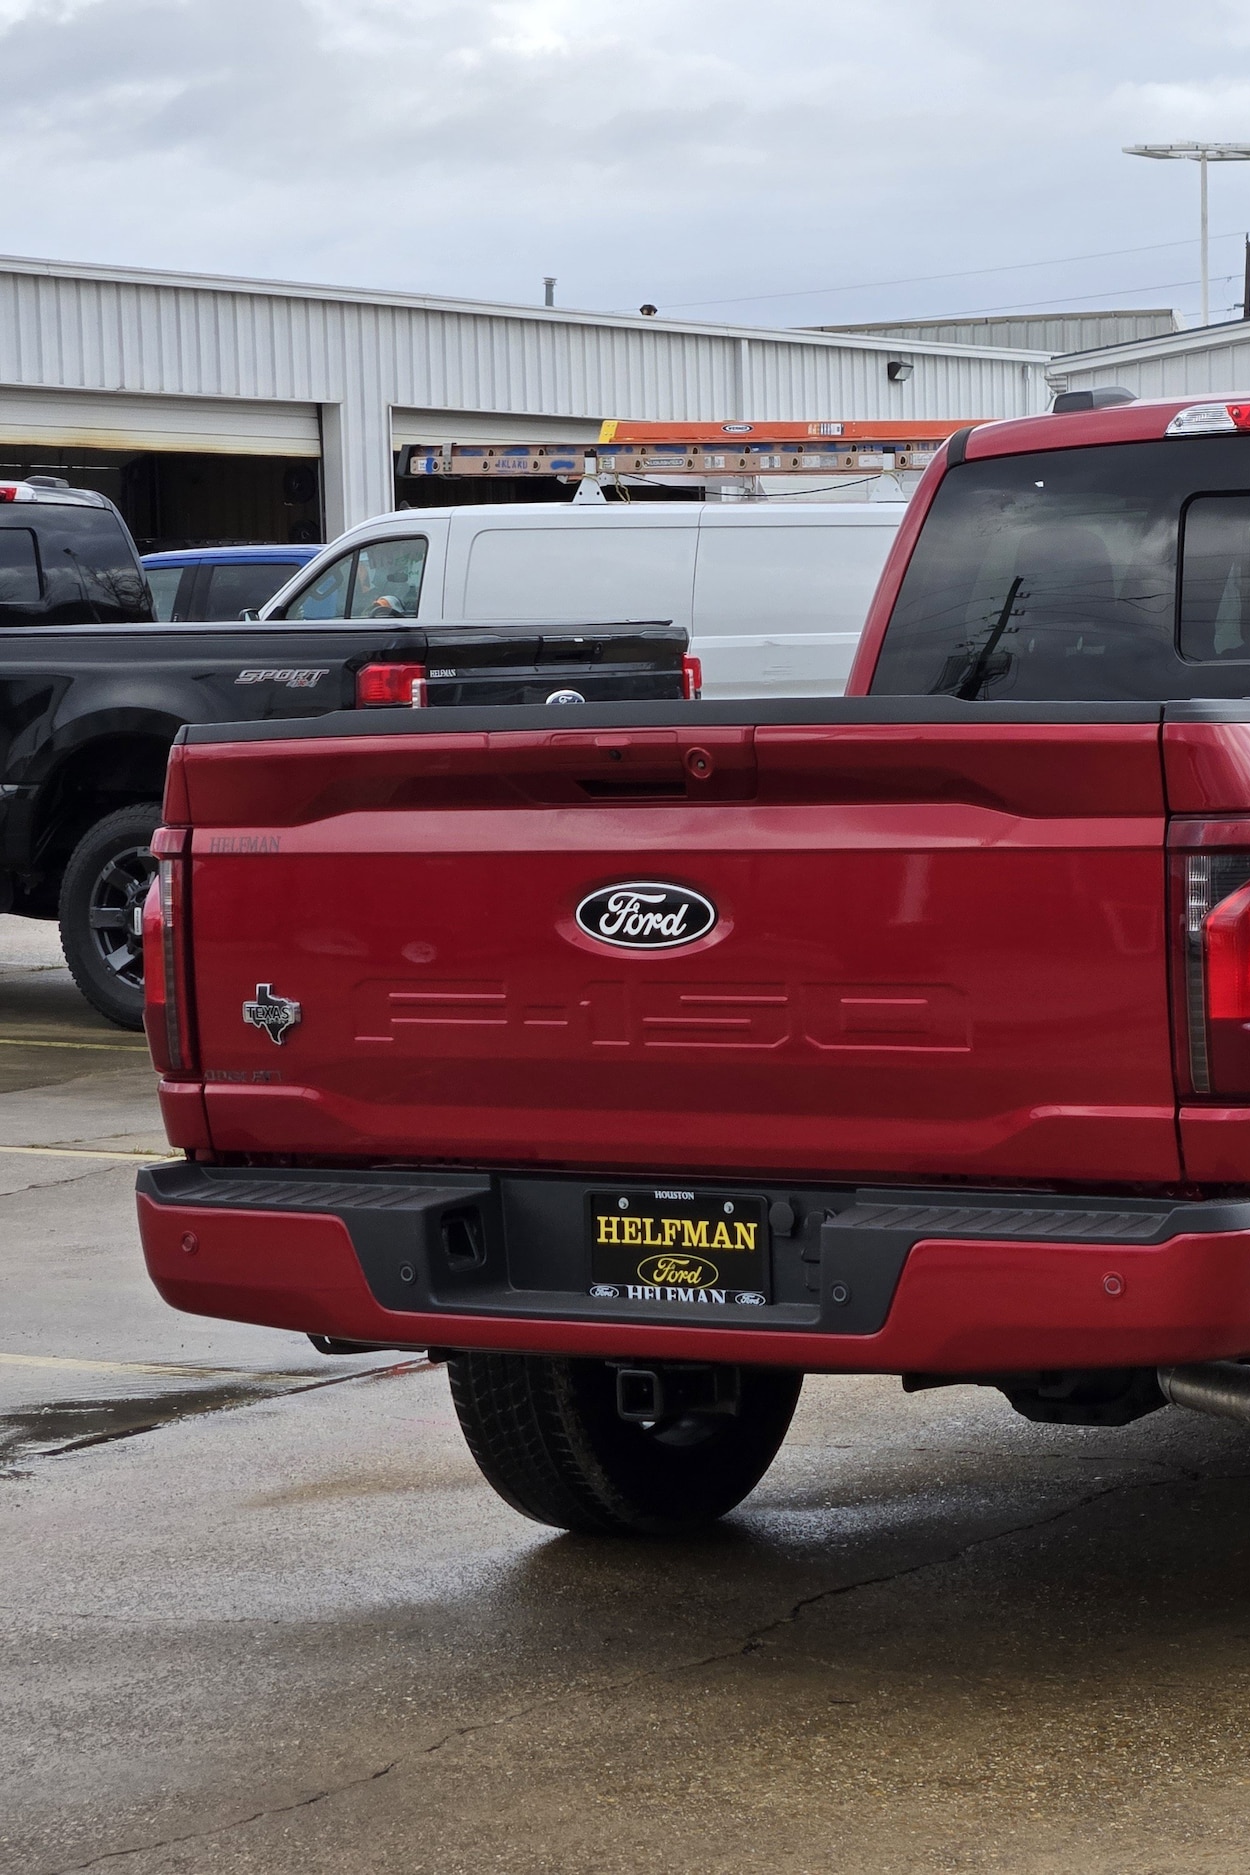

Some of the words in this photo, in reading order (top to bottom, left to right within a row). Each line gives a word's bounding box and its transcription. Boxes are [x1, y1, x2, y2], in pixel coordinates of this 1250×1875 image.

[234, 669, 330, 684] SPORT
[430, 669, 457, 678] HELFMAN
[209, 835, 282, 855] HELFMAN
[600, 891, 690, 936] Ford
[246, 1006, 289, 1020] TEXAS
[352, 977, 972, 1052] F-150
[654, 1191, 695, 1200] HOUSTON
[597, 1216, 758, 1250] HELFMAN
[652, 1257, 703, 1285] Ford
